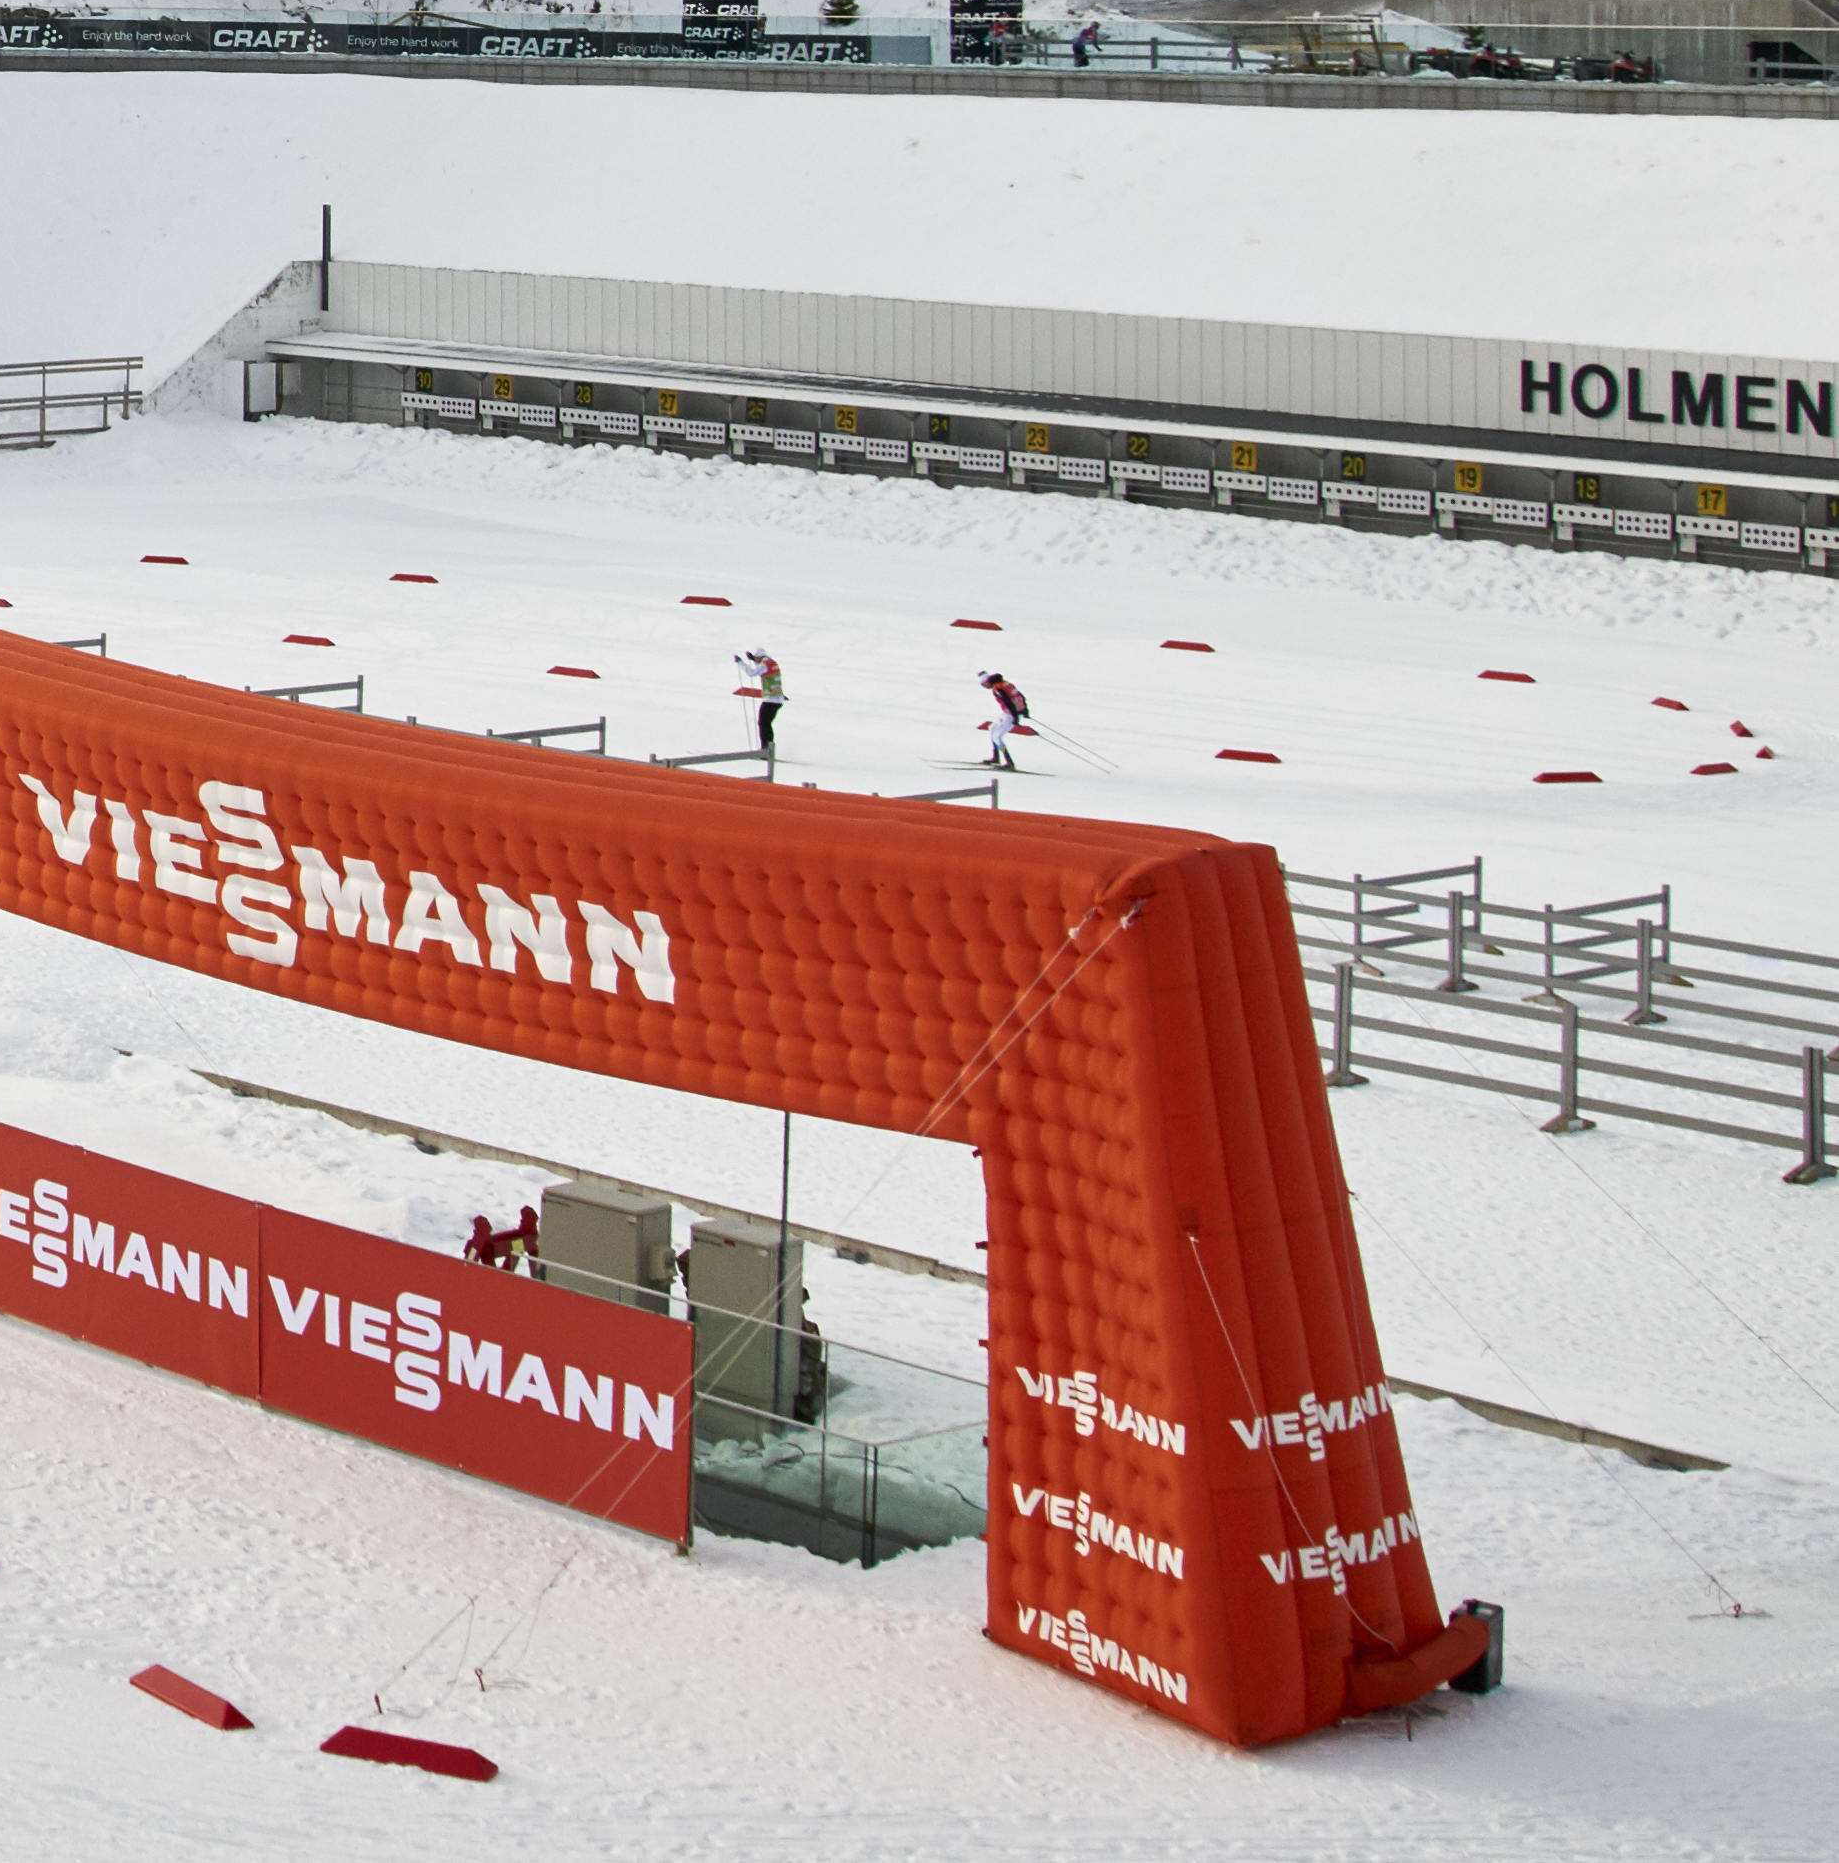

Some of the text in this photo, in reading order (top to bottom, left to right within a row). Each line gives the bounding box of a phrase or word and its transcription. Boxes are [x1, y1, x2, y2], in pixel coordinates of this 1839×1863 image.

[717, 4, 758, 16] CRAF
[82, 30, 192, 42] Enjoy the hard work
[213, 29, 305, 48] CRAFT
[347, 35, 459, 48] Enjoy the hard work
[685, 27, 732, 39] CRAFT
[480, 35, 573, 56] CRAFT
[715, 49, 757, 60] CRAF
[417, 370, 432, 389] 30
[495, 377, 510, 396] 29
[660, 393, 676, 412] 27
[1521, 359, 1833, 437] HOLMEN
[837, 410, 855, 429] 25
[1027, 427, 1046, 448] 23
[1130, 436, 1148, 456] 22
[1235, 446, 1253, 466] 21
[1343, 456, 1364, 477] 20
[1458, 467, 1478, 488] 19
[1577, 478, 1598, 500] 18
[1700, 489, 1723, 511] 17
[18, 773, 676, 1005] VIESSMANN
[267, 1274, 676, 1451] VIESSMANN
[1015, 1366, 1186, 1456] VIESSMANN
[1011, 1482, 1185, 1580] VIESSMANN
[1016, 1601, 1189, 1705] VIESSMANN
